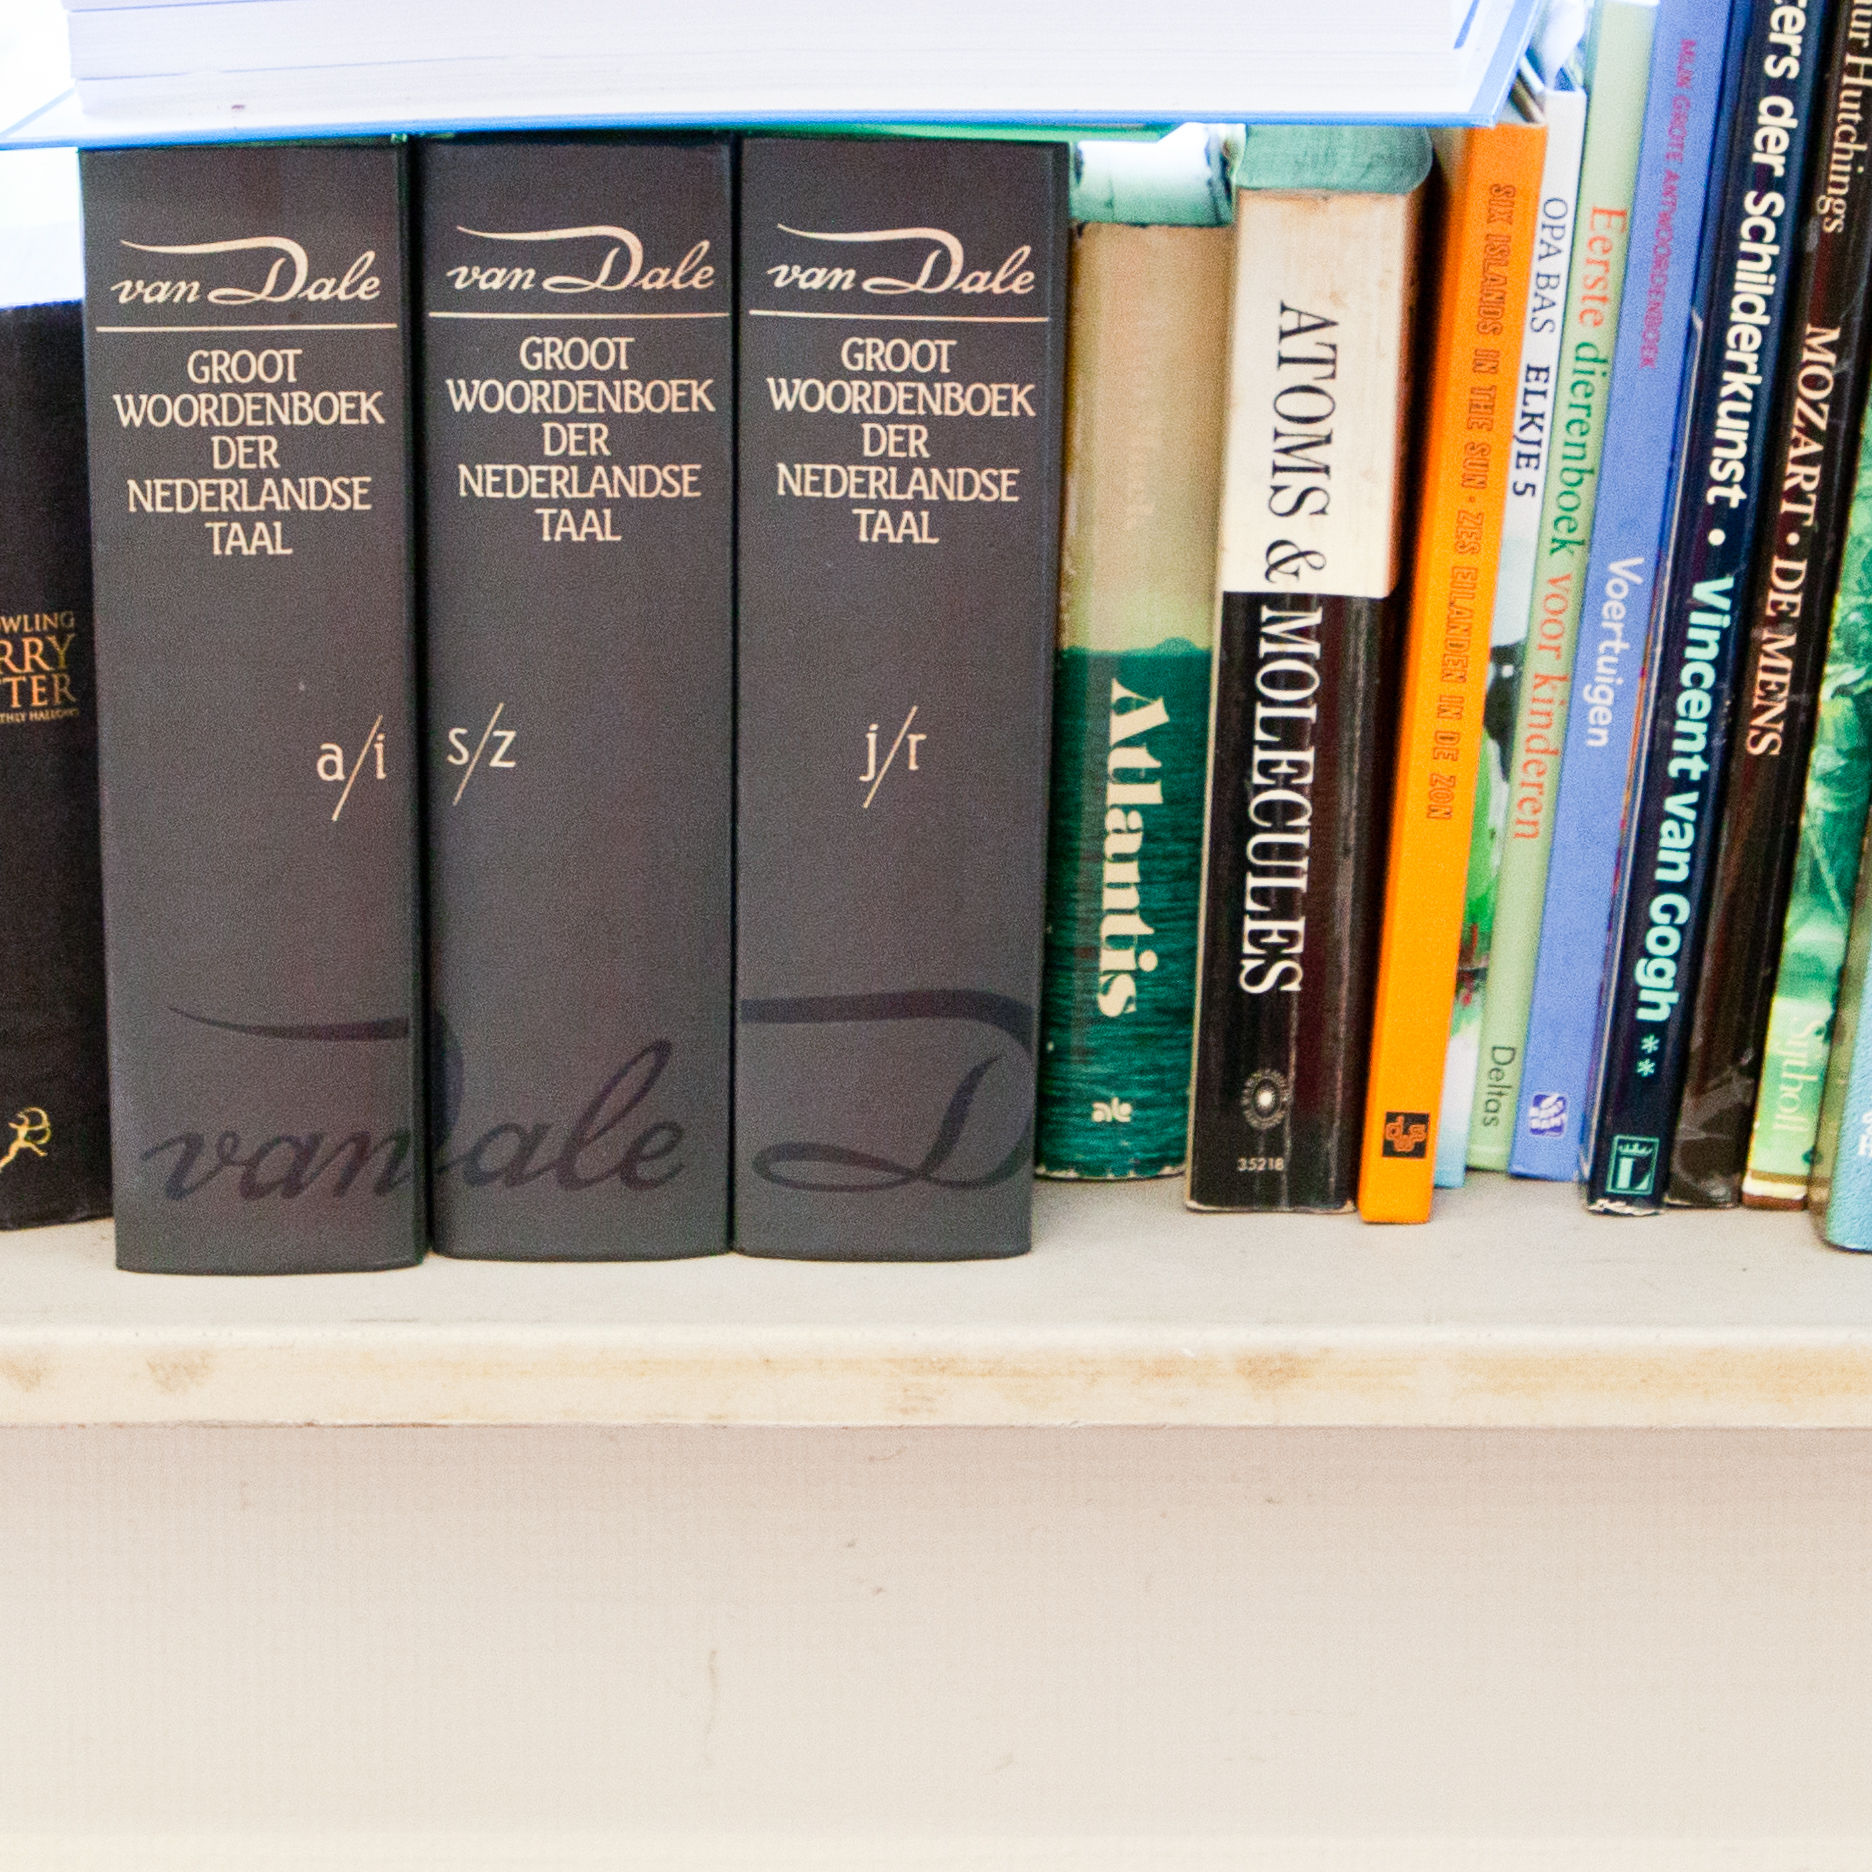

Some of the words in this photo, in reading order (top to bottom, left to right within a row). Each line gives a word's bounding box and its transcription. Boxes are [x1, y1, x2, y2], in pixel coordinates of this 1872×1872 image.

[1665, 95, 1691, 163] GROTE
[1752, 95, 1798, 178] der
[1487, 183, 1516, 225] SIX
[1538, 198, 1568, 261] OPA
[120, 235, 380, 304] Dale
[447, 261, 530, 291] van
[456, 225, 714, 292] Dale
[767, 261, 855, 292] van
[777, 223, 1034, 296] Dale
[1478, 234, 1511, 336] ISLANDS
[1578, 206, 1627, 328] Eerste
[1639, 168, 1680, 369] ANTWOORDENBOEK
[112, 275, 200, 304] van
[1530, 272, 1561, 334] BAS
[187, 349, 302, 385] GROOT
[519, 337, 634, 372] GROOT
[840, 338, 956, 373] GROOT
[1473, 348, 1500, 375] IN
[1706, 190, 1785, 509] schilderkunst
[112, 389, 385, 427] WOORDENBOEK
[445, 377, 716, 413] WOORDENBOEK
[766, 377, 1036, 417] WOORDENBOEK
[1275, 299, 1340, 520] ATOMS
[1467, 385, 1497, 431] THE
[1514, 363, 1551, 472] ELKJE
[1781, 322, 1842, 526] MOZART
[211, 435, 279, 469] DER
[542, 422, 609, 456] DER
[861, 423, 930, 457] DER
[1461, 441, 1491, 489] SUN
[1549, 341, 1609, 557] dierenboek
[126, 476, 371, 513] NEDERLANDSE
[456, 463, 702, 499] NEDERLANDSE
[776, 464, 1021, 503] NEDERLANDSE
[1512, 482, 1536, 498] 5
[205, 520, 292, 556] TAAL
[534, 506, 622, 541] TAAL
[852, 507, 939, 544] TAAL
[1455, 510, 1484, 555] ZES
[1261, 539, 1304, 584] &
[1765, 559, 1808, 617] DE
[1442, 566, 1477, 683] EILANDEN
[1537, 572, 1572, 661] voor
[1583, 556, 1645, 748] Voertuigen
[1668, 575, 1733, 779] Vincent
[1437, 695, 1464, 719] IN
[1746, 632, 1795, 758] MENS
[317, 716, 386, 822] a/i
[447, 703, 517, 806] s/z
[859, 705, 926, 808] j/r
[1433, 730, 1460, 762] DE
[1513, 672, 1571, 840] kinderen
[1239, 602, 1322, 997] MOLECULES
[1427, 773, 1454, 820] ZON
[1097, 678, 1171, 1018] Atlantis
[1656, 790, 1702, 887] van
[1635, 895, 1692, 1023] Gogh
[1482, 1044, 1516, 1127] Deltas
[1238, 1157, 1285, 1172] 35218
